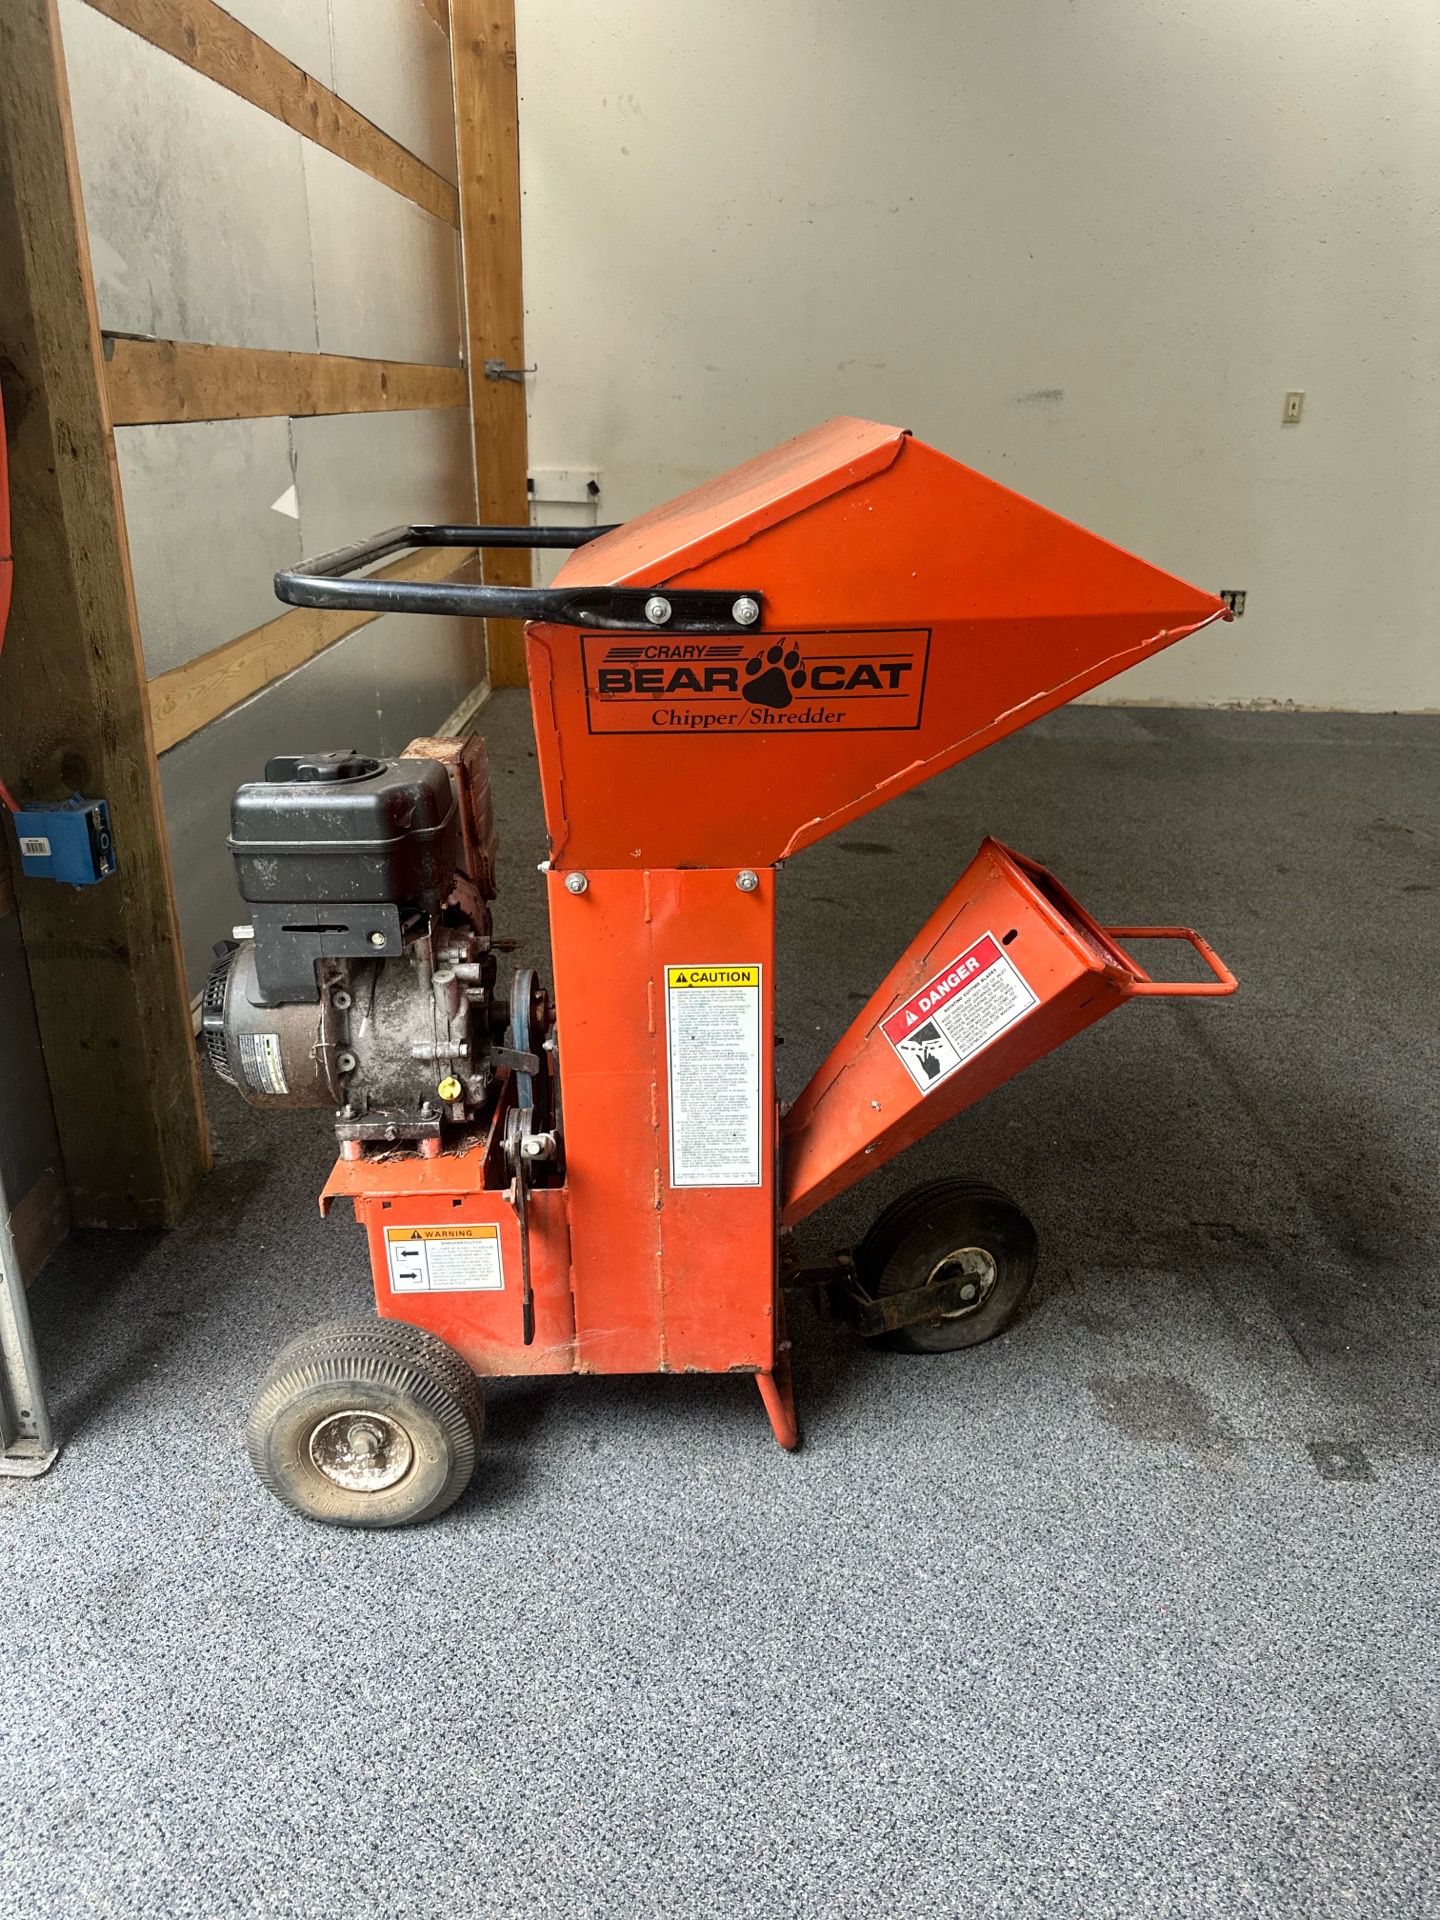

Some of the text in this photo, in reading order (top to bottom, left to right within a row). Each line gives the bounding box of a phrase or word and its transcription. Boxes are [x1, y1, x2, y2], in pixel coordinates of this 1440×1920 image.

[644, 645, 707, 659] CRARY
[598, 662, 913, 694] BEAR CAT
[651, 706, 847, 729] Chipper/Shredder
[690, 971, 751, 983] CAUTION
[917, 956, 981, 1013] DANGER
[425, 1230, 473, 1238] WARNING
